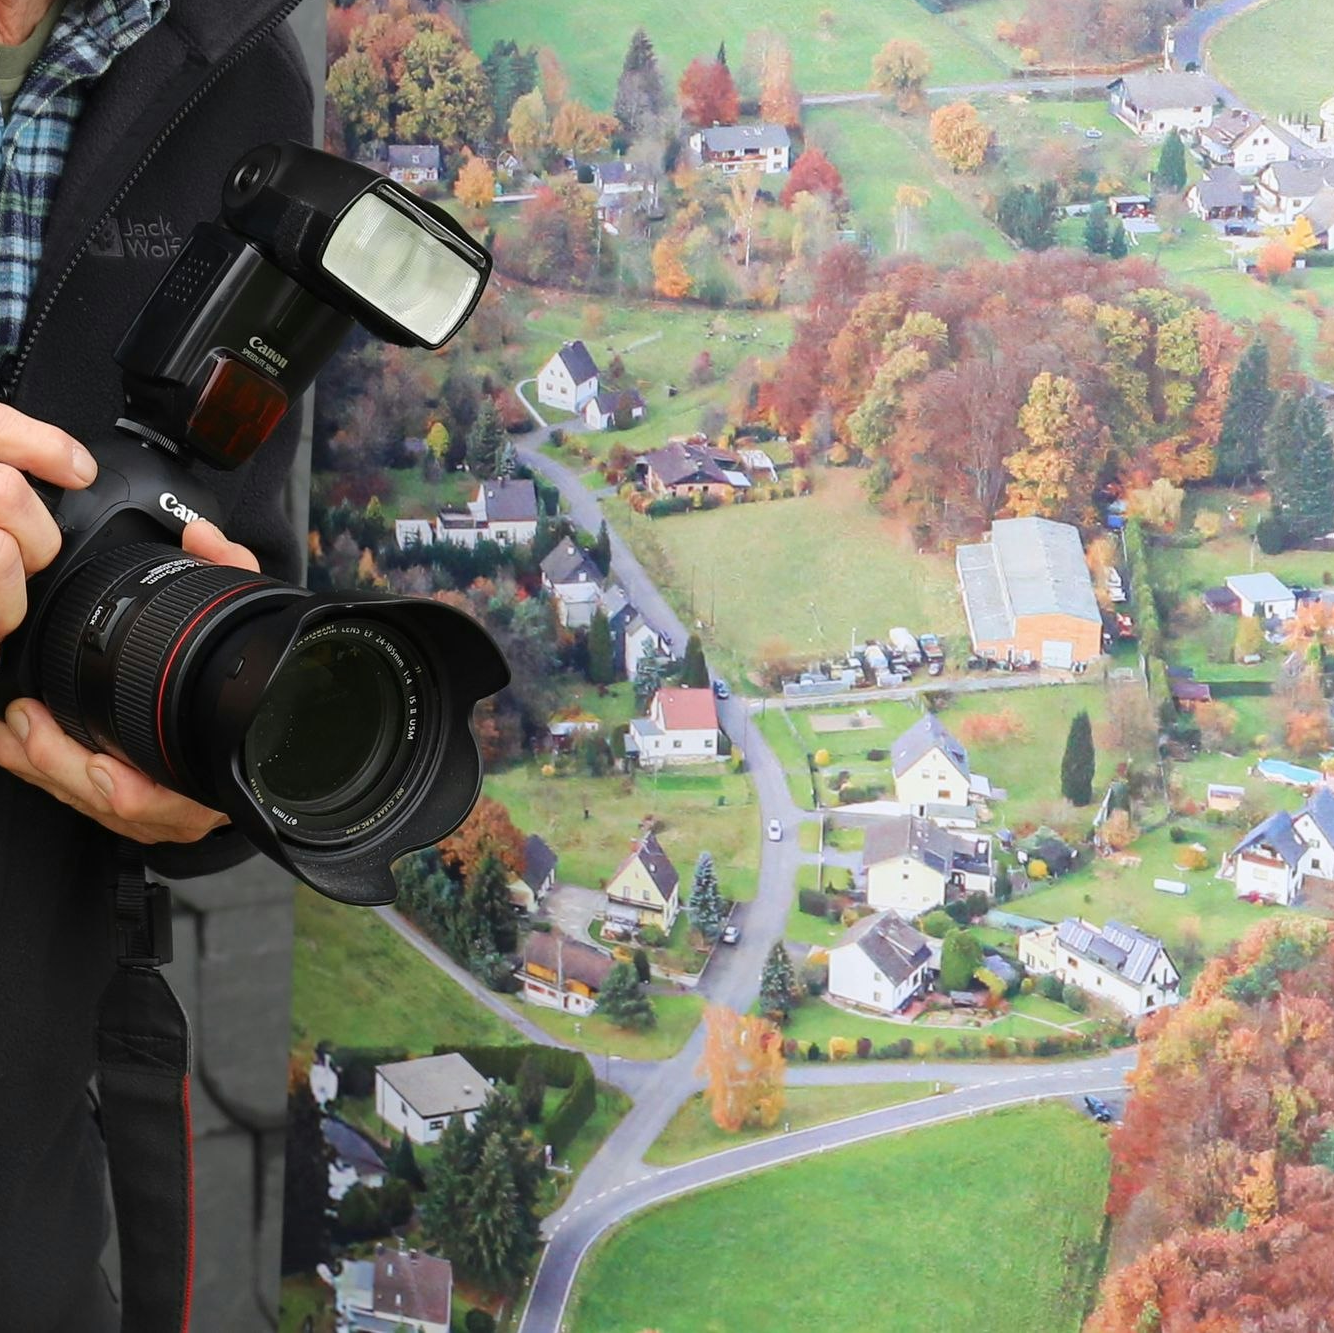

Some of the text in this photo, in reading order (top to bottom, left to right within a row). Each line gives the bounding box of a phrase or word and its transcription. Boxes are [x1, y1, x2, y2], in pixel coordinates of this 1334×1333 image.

[123, 214, 173, 237] Jack
[249, 336, 288, 369] Canon
[159, 492, 207, 524] Can
[89, 605, 104, 626] LOCK
[409, 695, 417, 705] IS
[407, 719, 416, 740] USM
[377, 800, 395, 818] CLEAR
